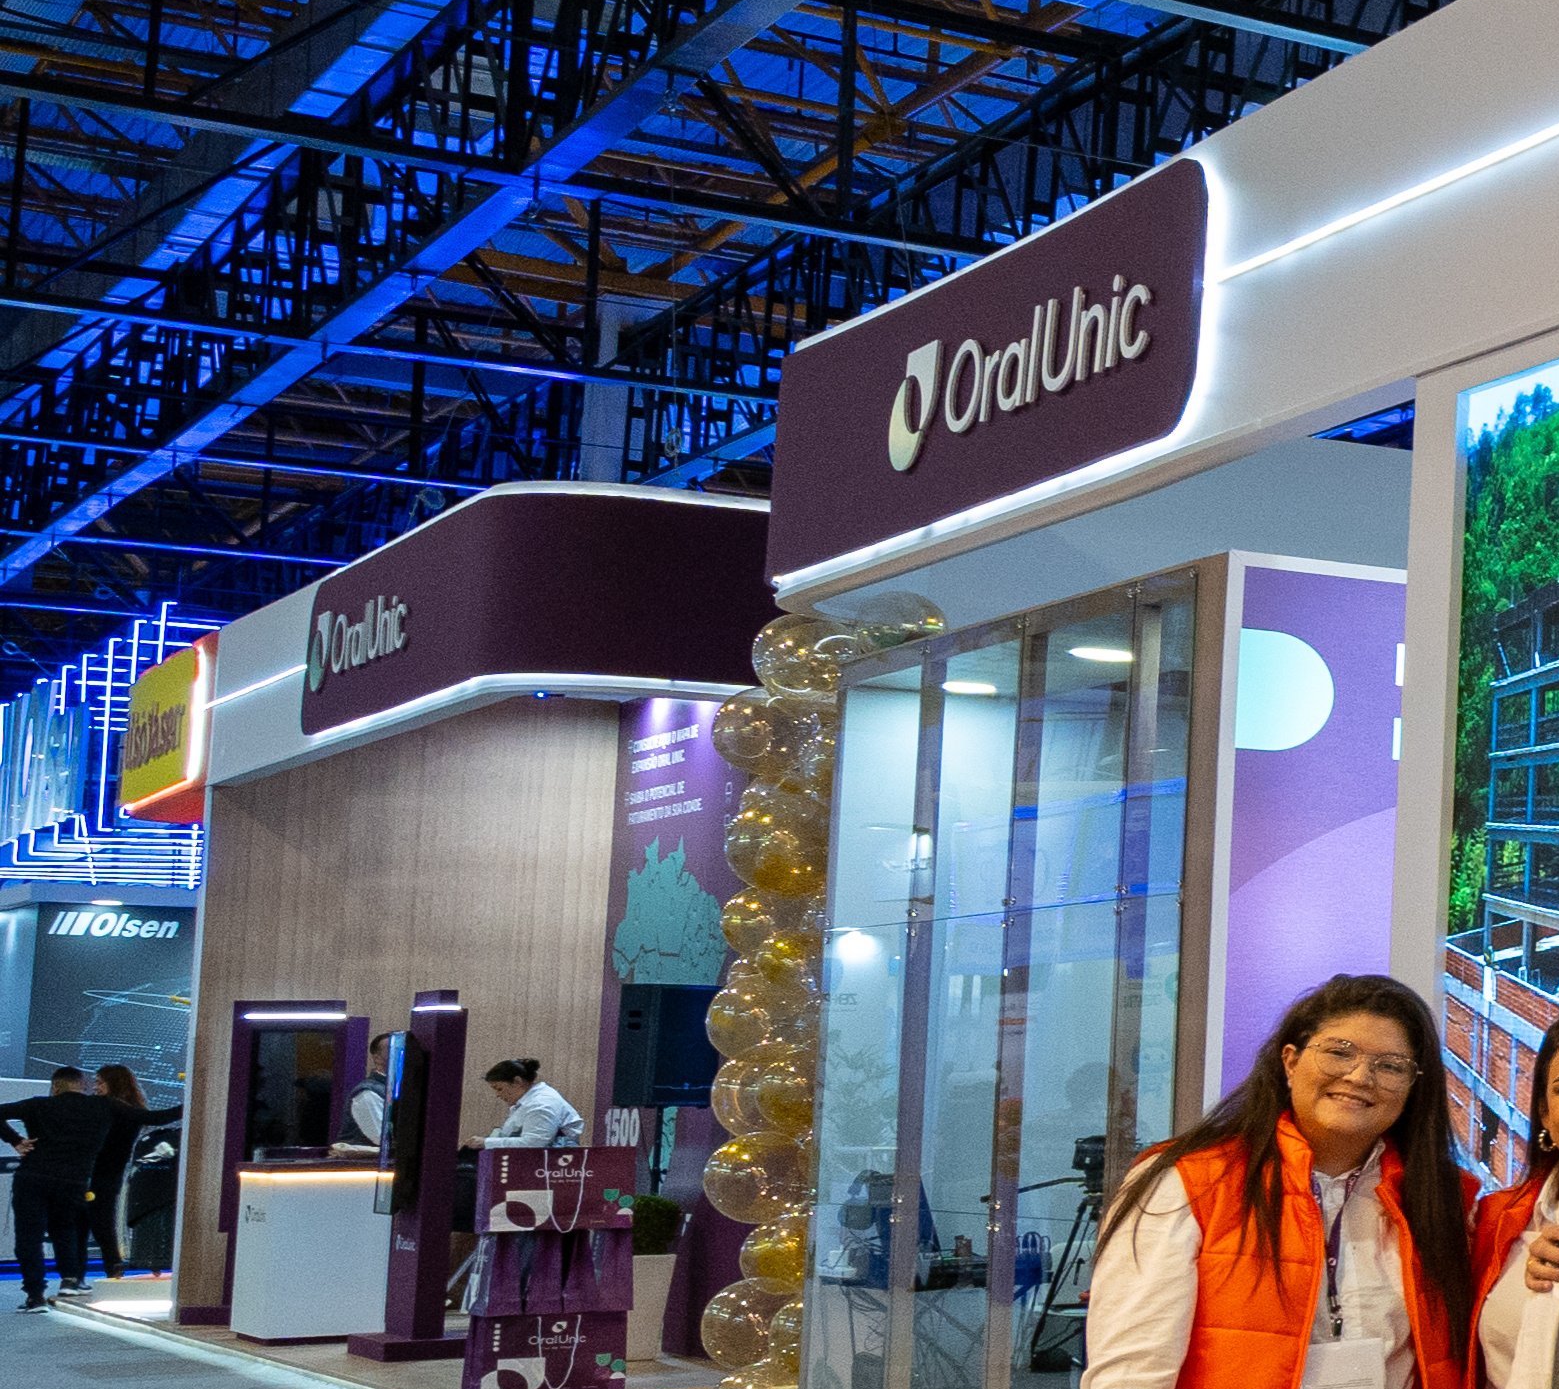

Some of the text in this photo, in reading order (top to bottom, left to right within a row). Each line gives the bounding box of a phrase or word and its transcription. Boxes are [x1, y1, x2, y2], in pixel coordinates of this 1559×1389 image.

[945, 273, 1152, 433] OralUnic
[90, 912, 180, 939] Olsen
[604, 1108, 640, 1147] 1500
